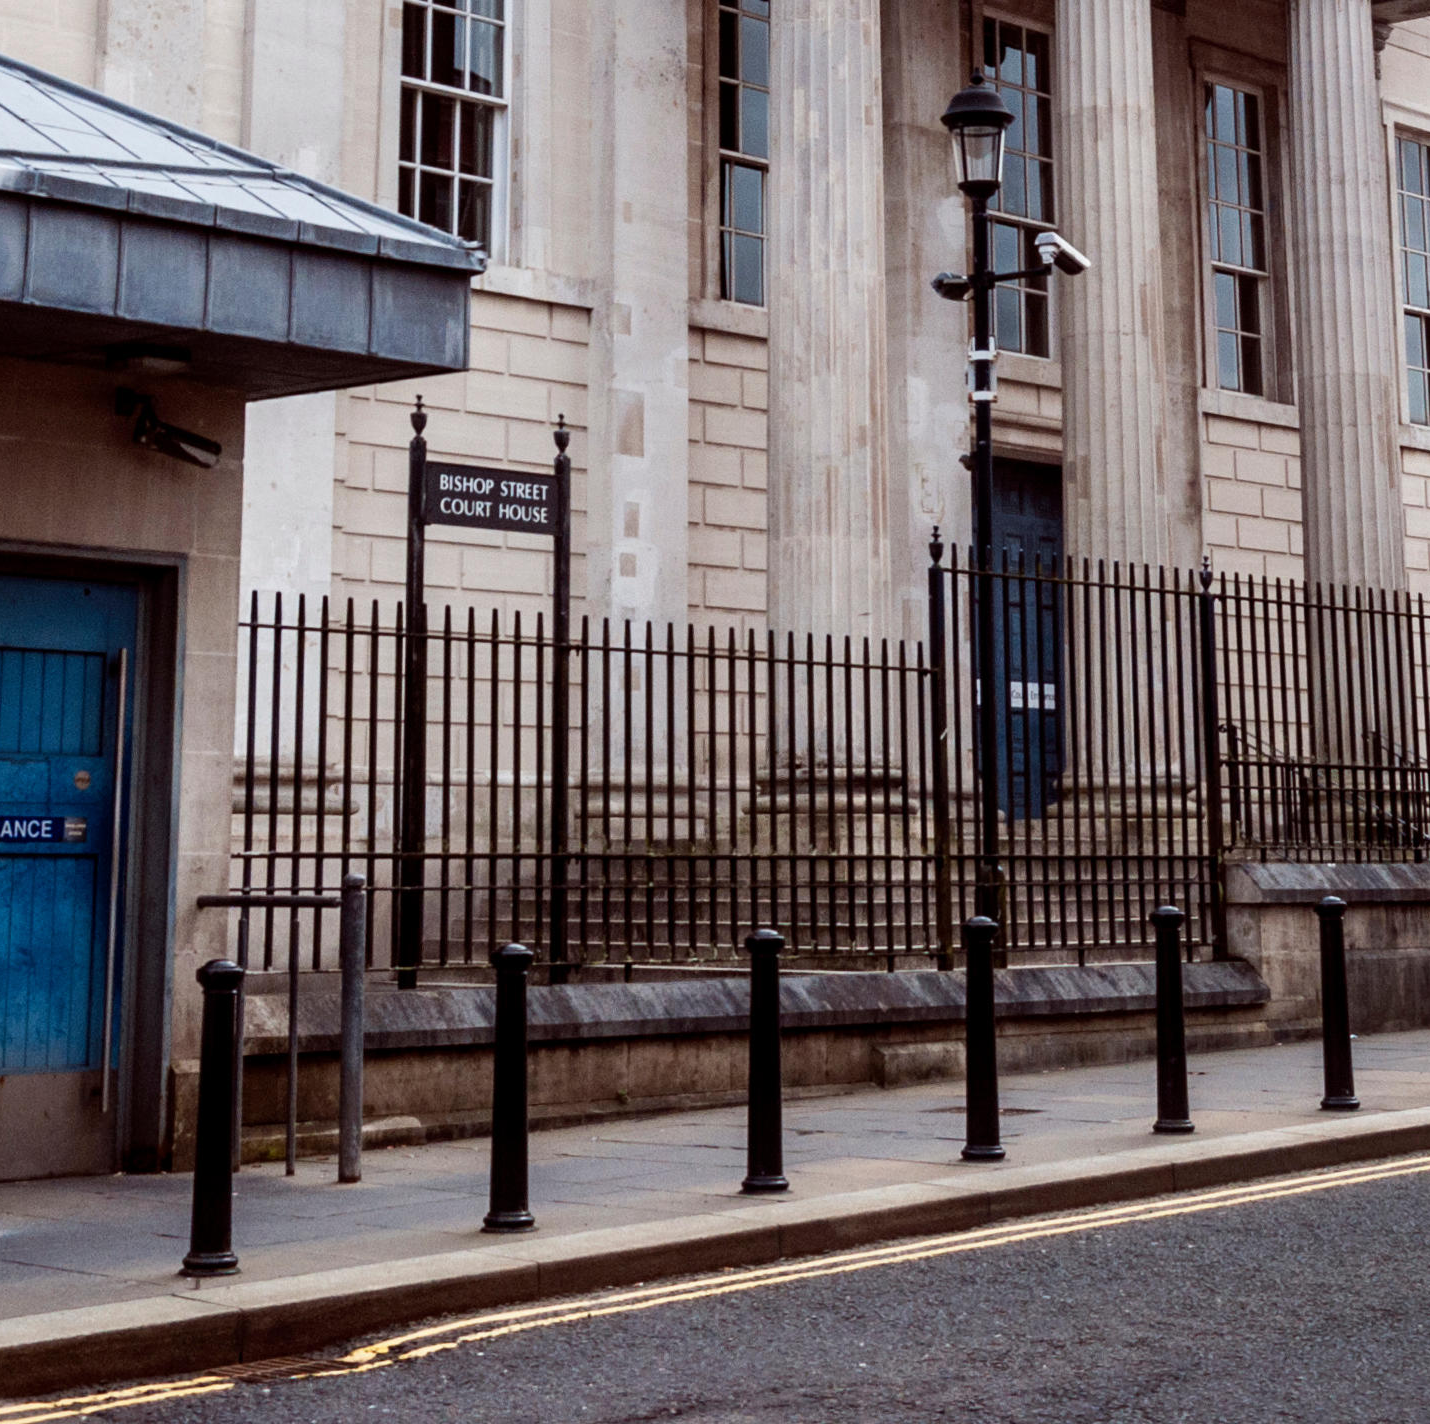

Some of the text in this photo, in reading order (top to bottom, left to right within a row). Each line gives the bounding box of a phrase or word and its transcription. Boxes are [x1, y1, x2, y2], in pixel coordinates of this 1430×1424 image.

[439, 473, 549, 501] BISHOP STREET
[439, 497, 548, 524] COURT HOUSE
